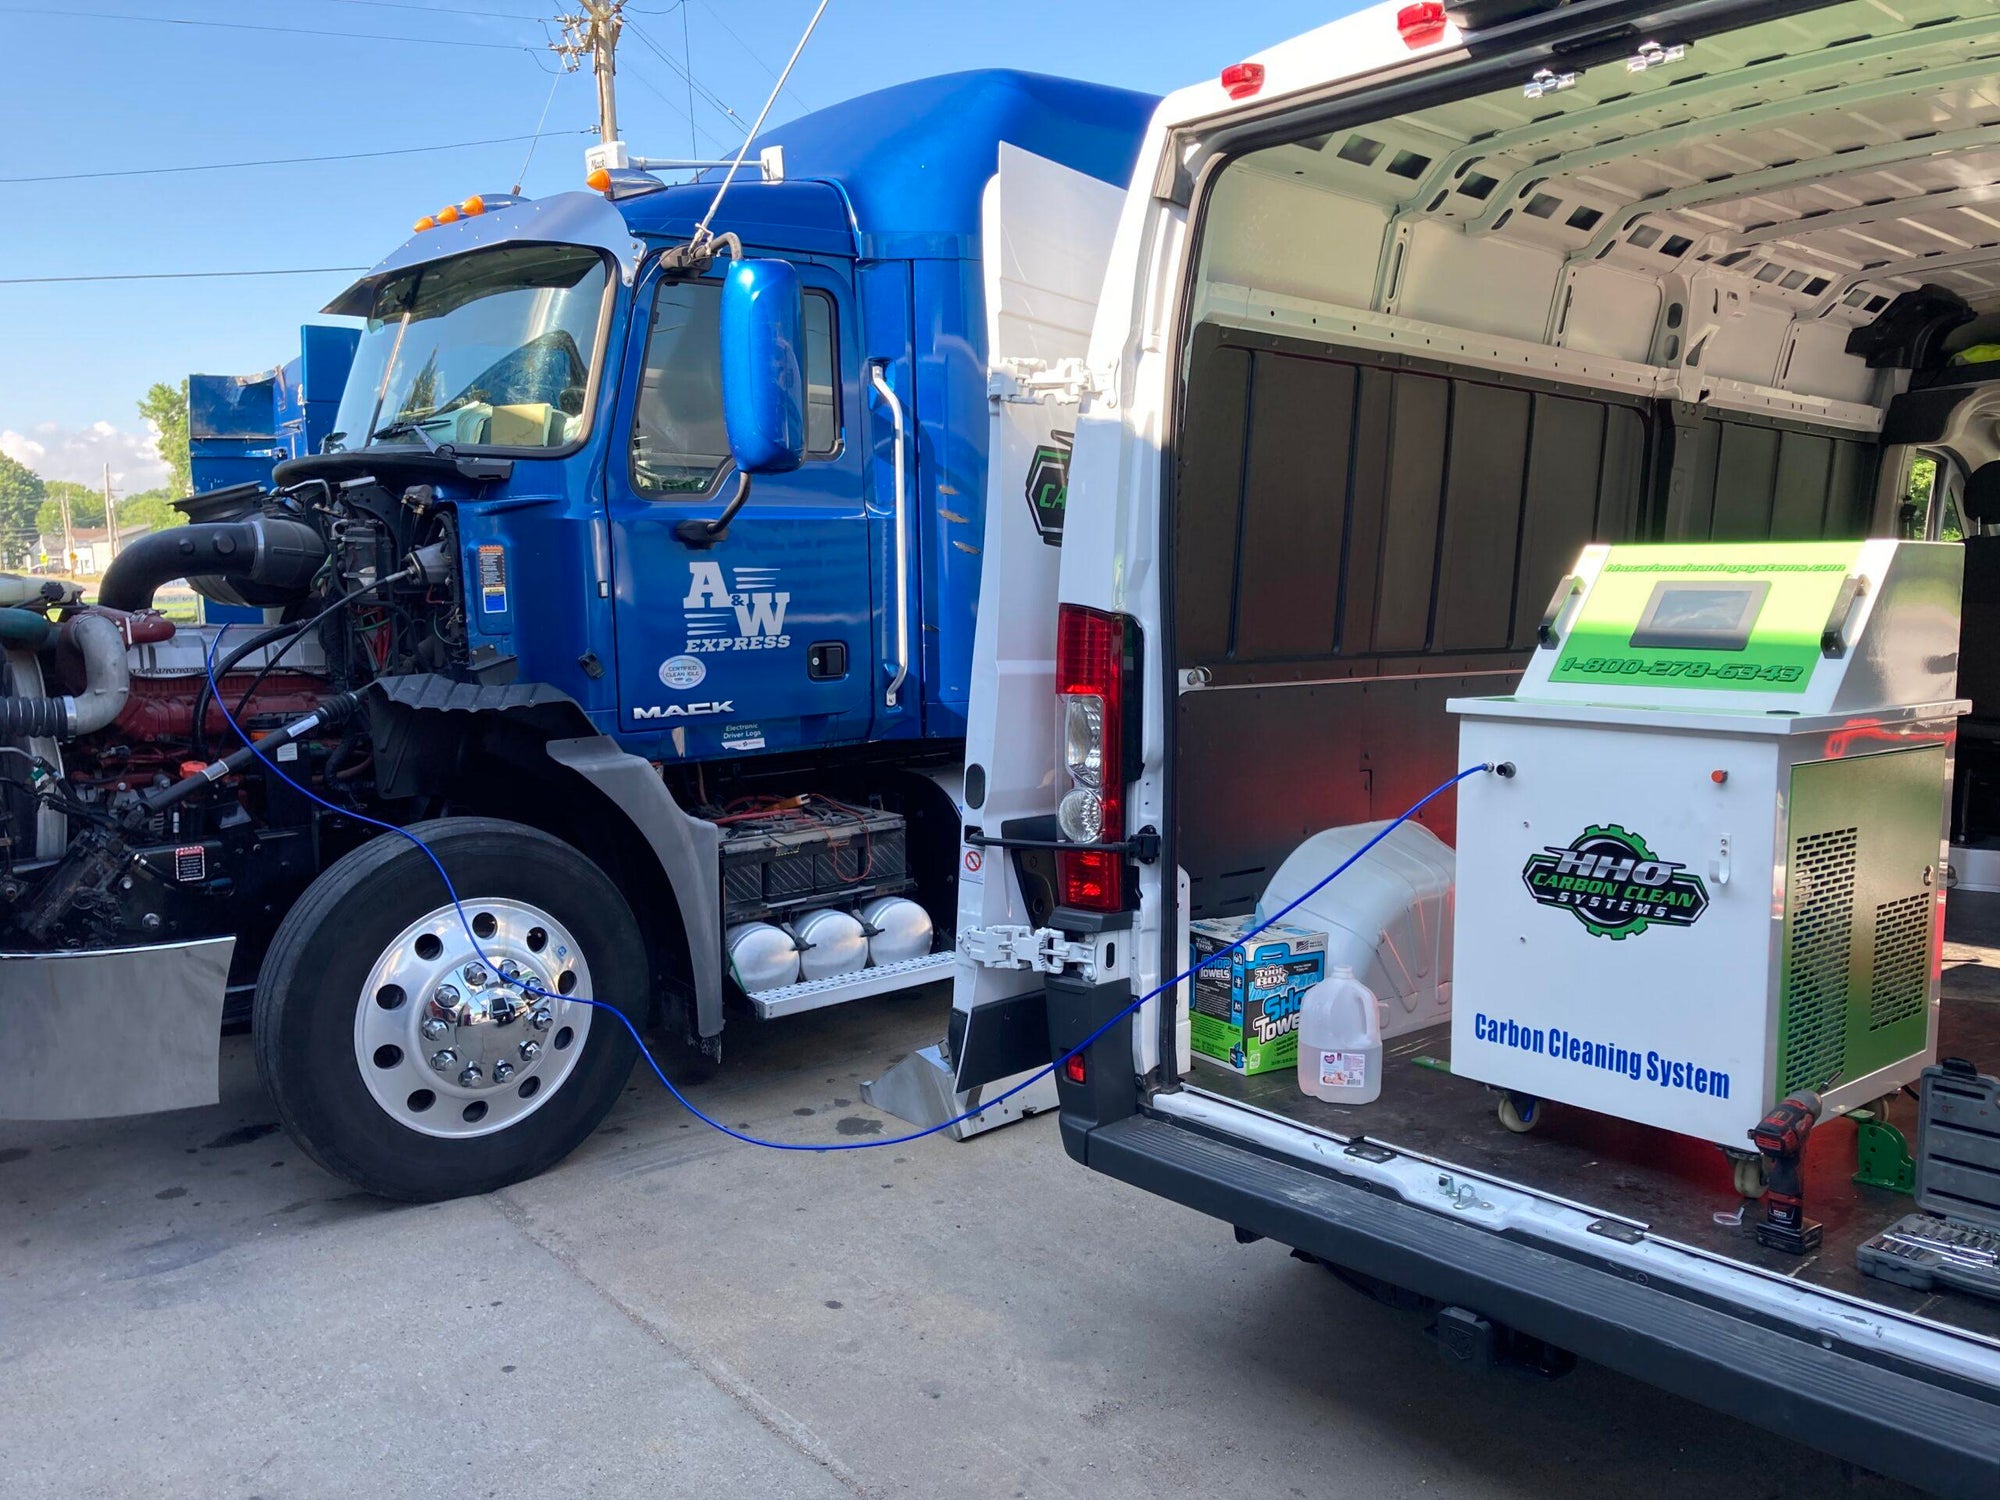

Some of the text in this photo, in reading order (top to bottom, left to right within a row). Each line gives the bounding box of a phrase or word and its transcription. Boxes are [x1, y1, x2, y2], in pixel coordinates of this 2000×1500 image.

[684, 635, 791, 653] EXPRESS
[1561, 657, 1803, 682] 1-800-278-6343
[633, 700, 735, 719] MACK
[726, 723, 759, 732] Electronic
[745, 730, 761, 738] Logs
[1550, 850, 1677, 887] HHO
[1532, 872, 1697, 908] CARBON CLEAN
[1557, 891, 1668, 918] SYSTEMS
[1256, 965, 1285, 978] TOOL
[1256, 973, 1287, 987] BOX
[1264, 988, 1305, 1021] SHO
[1255, 1013, 1301, 1044] TOWE
[1475, 1013, 1730, 1099] Carbon Cleaning System
